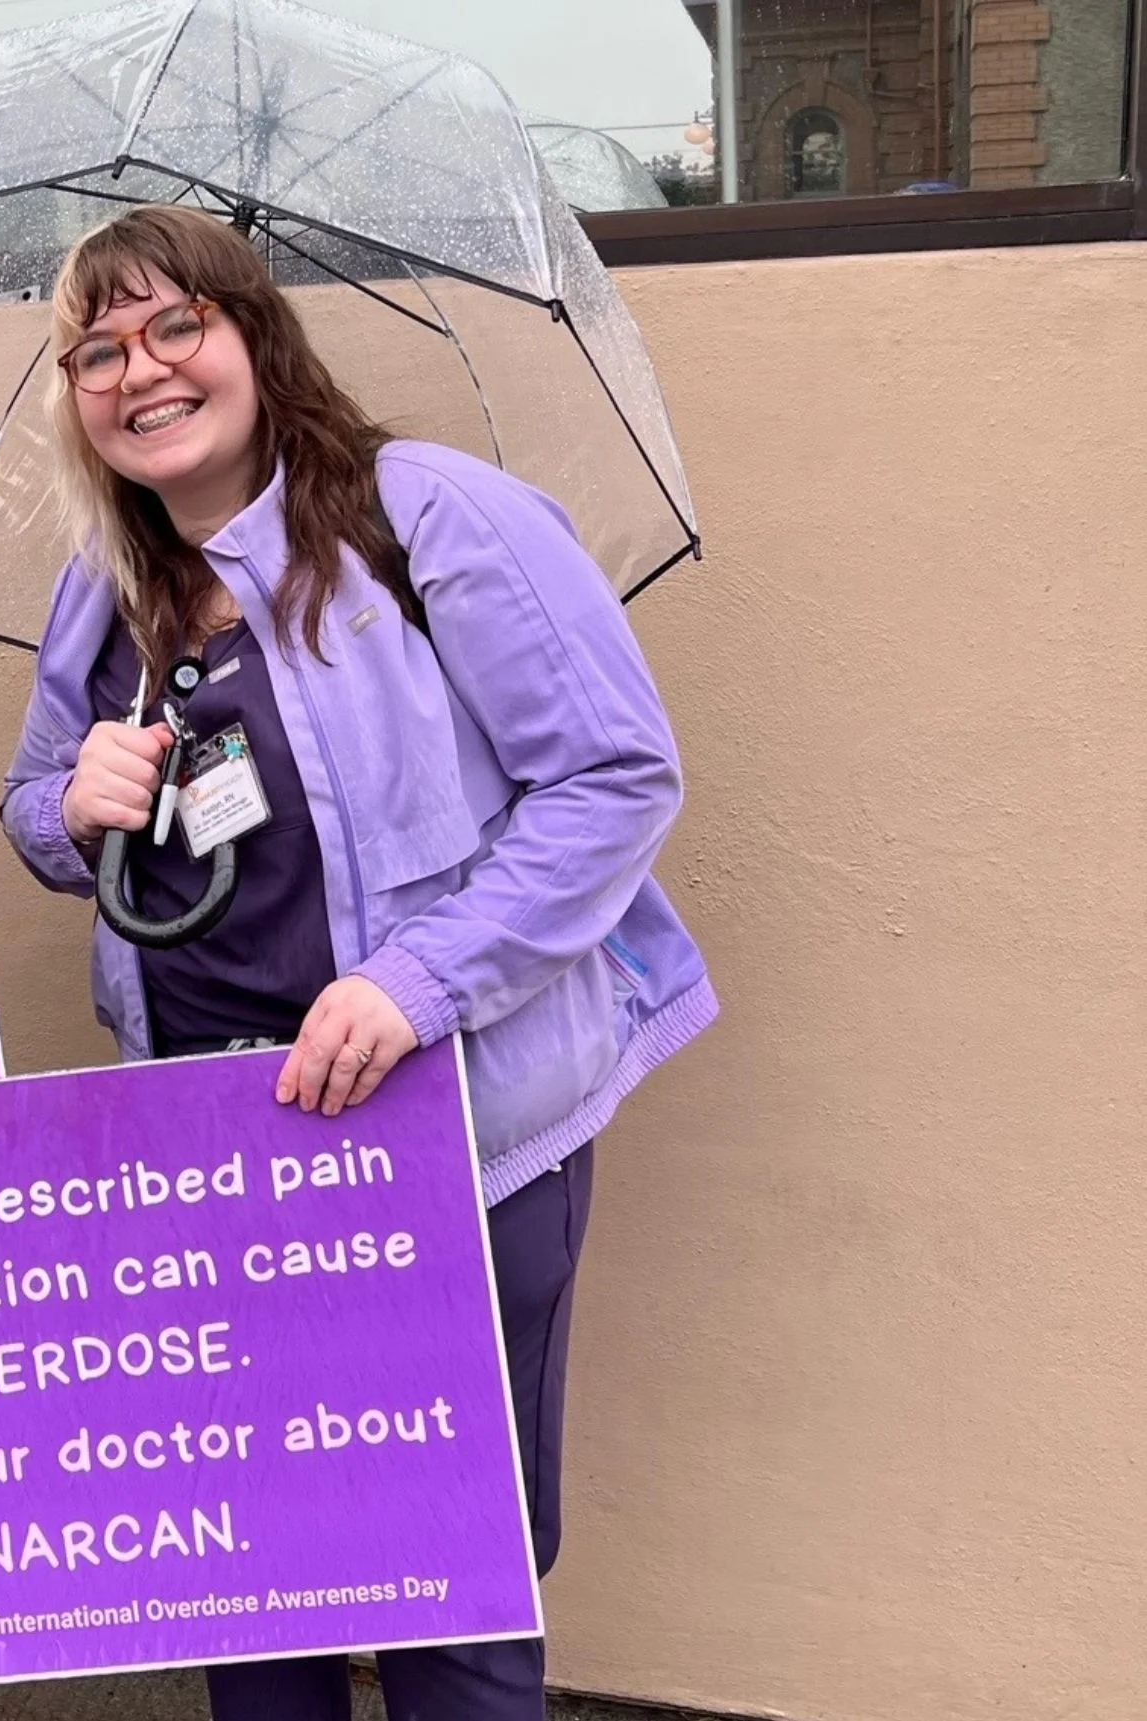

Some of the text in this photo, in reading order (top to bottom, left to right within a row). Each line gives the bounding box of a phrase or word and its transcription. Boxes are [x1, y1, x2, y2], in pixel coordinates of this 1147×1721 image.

[270, 1138, 393, 1201] pain
[113, 1249, 217, 1295] can
[243, 1232, 416, 1282] cause
[58, 1422, 254, 1472] doctor
[284, 1397, 455, 1452] about
[146, 1593, 259, 1621] Overdose
[266, 1583, 398, 1611] Awareness
[403, 1576, 449, 1602] Day
